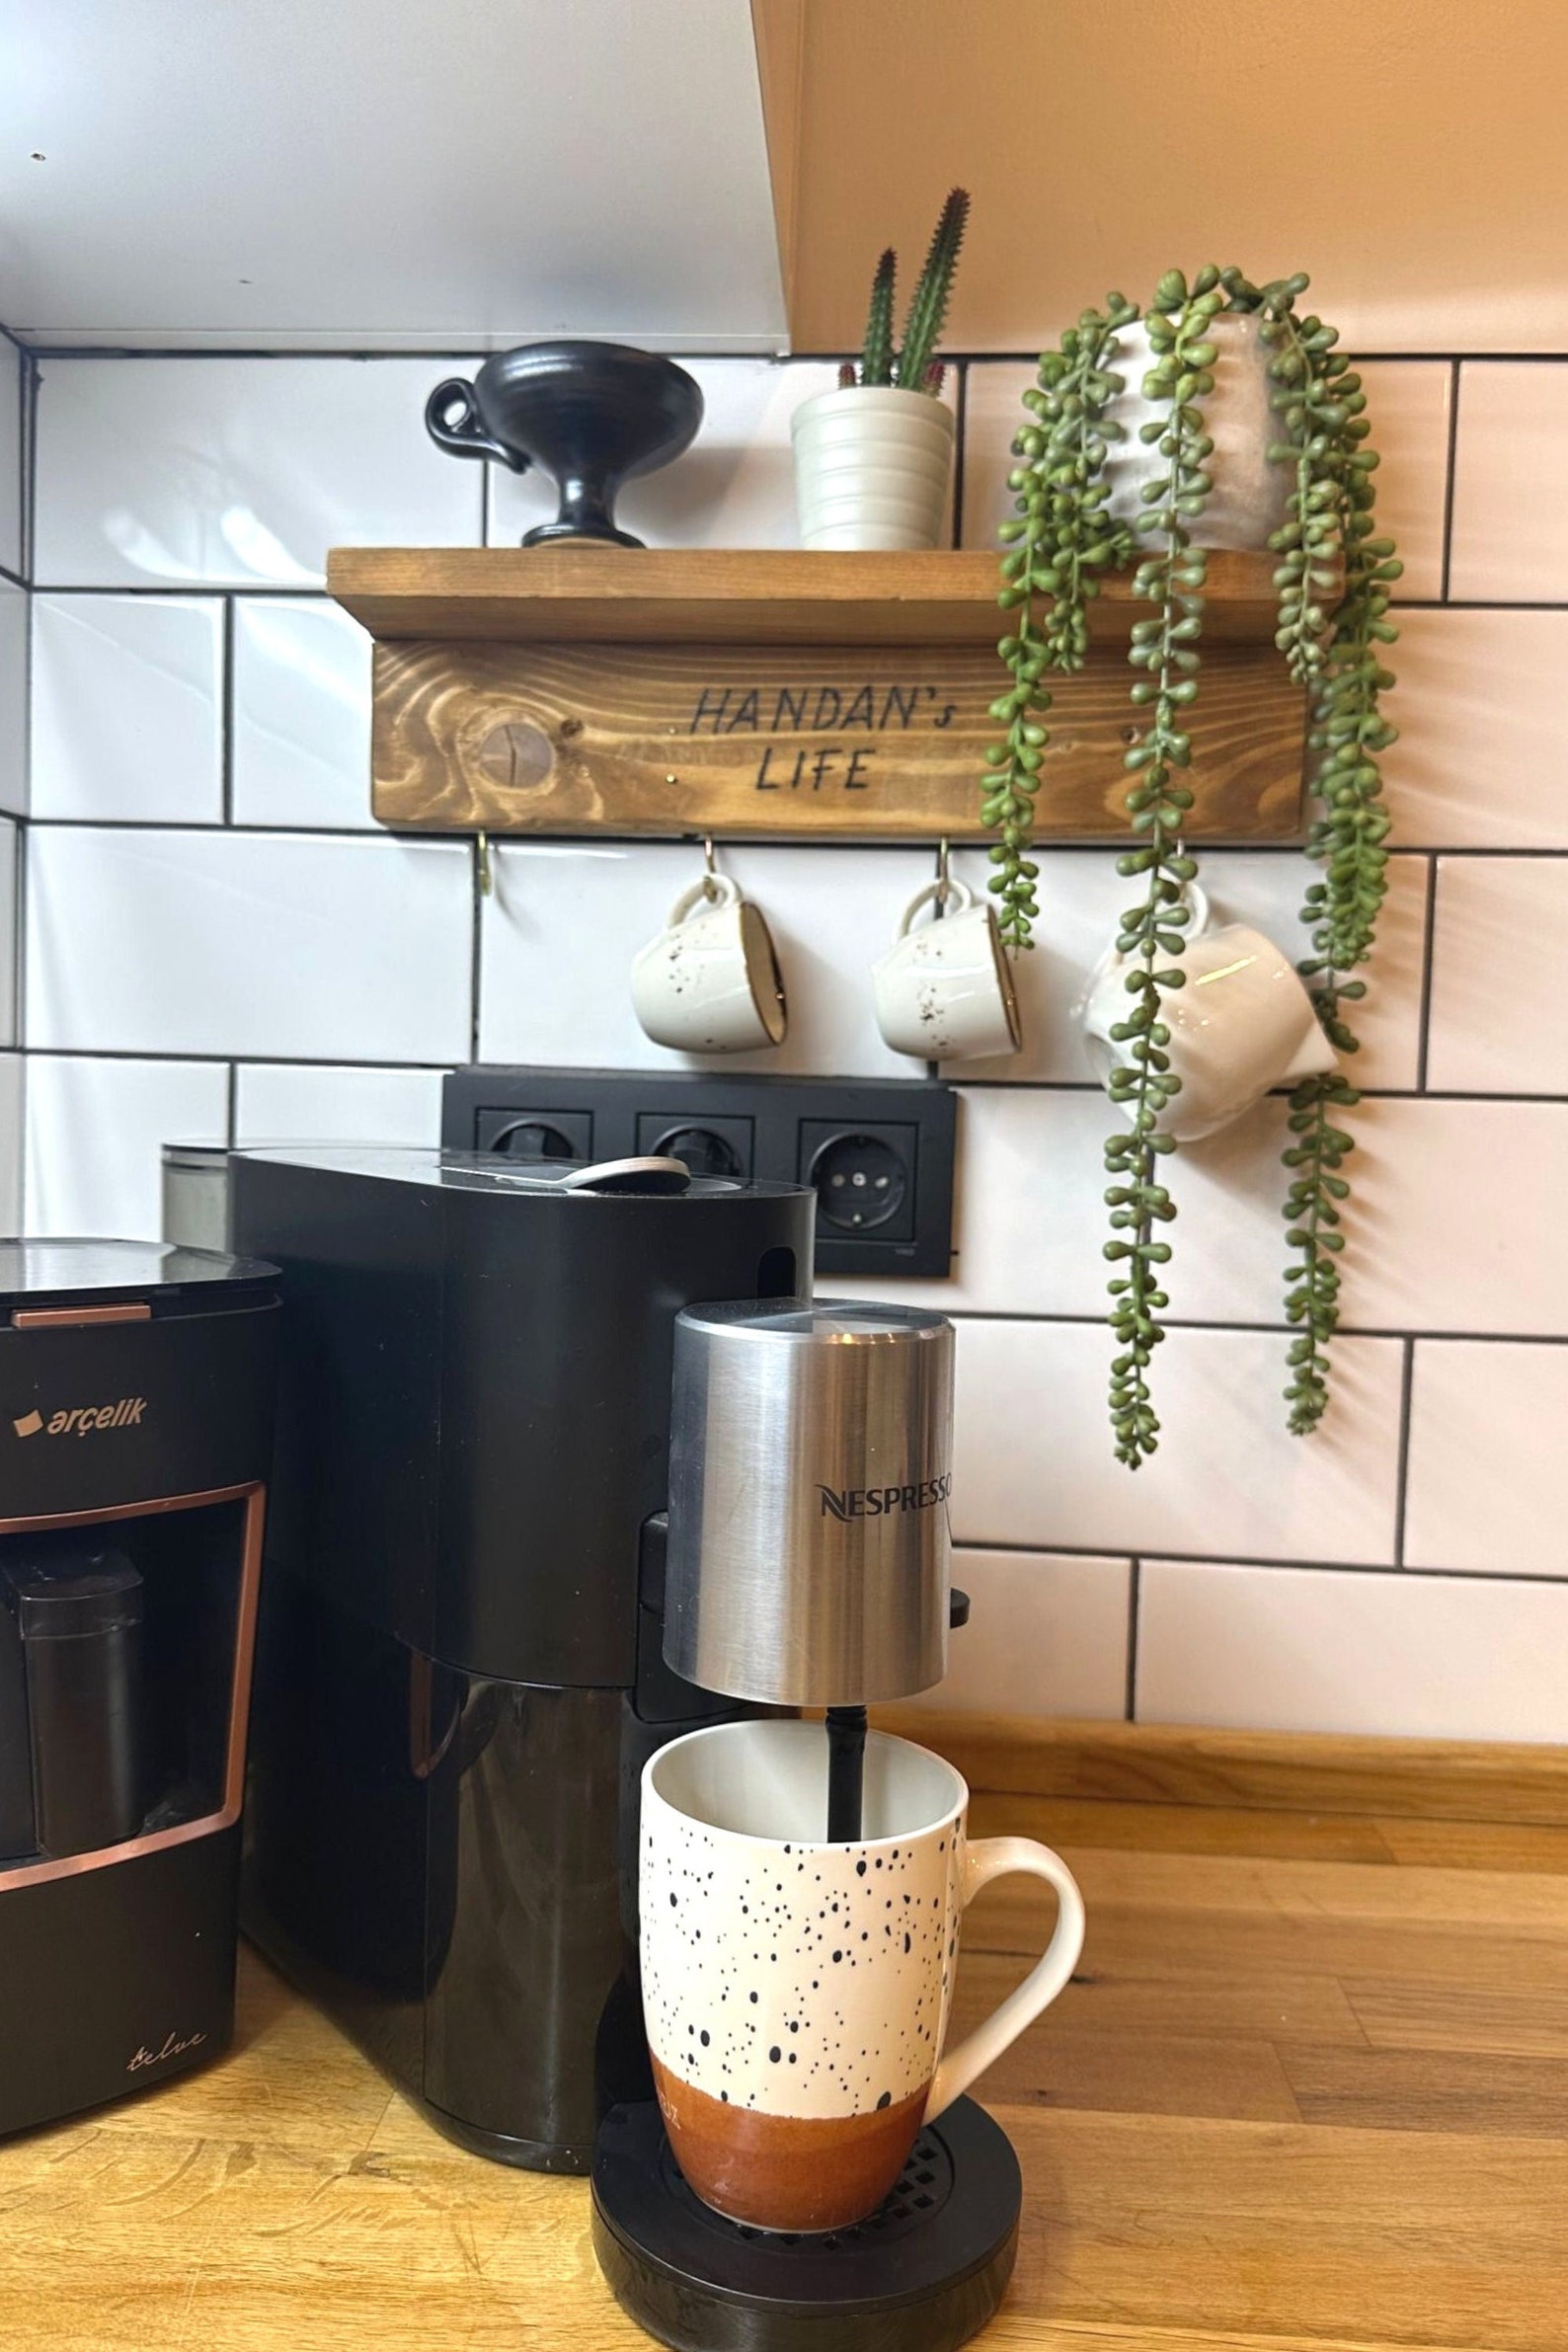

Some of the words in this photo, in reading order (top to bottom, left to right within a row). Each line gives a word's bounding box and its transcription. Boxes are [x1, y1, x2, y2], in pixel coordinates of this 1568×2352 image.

[690, 685, 958, 736] HANDAN's
[755, 747, 877, 791] LIFE
[46, 1397, 147, 1437] arçelik
